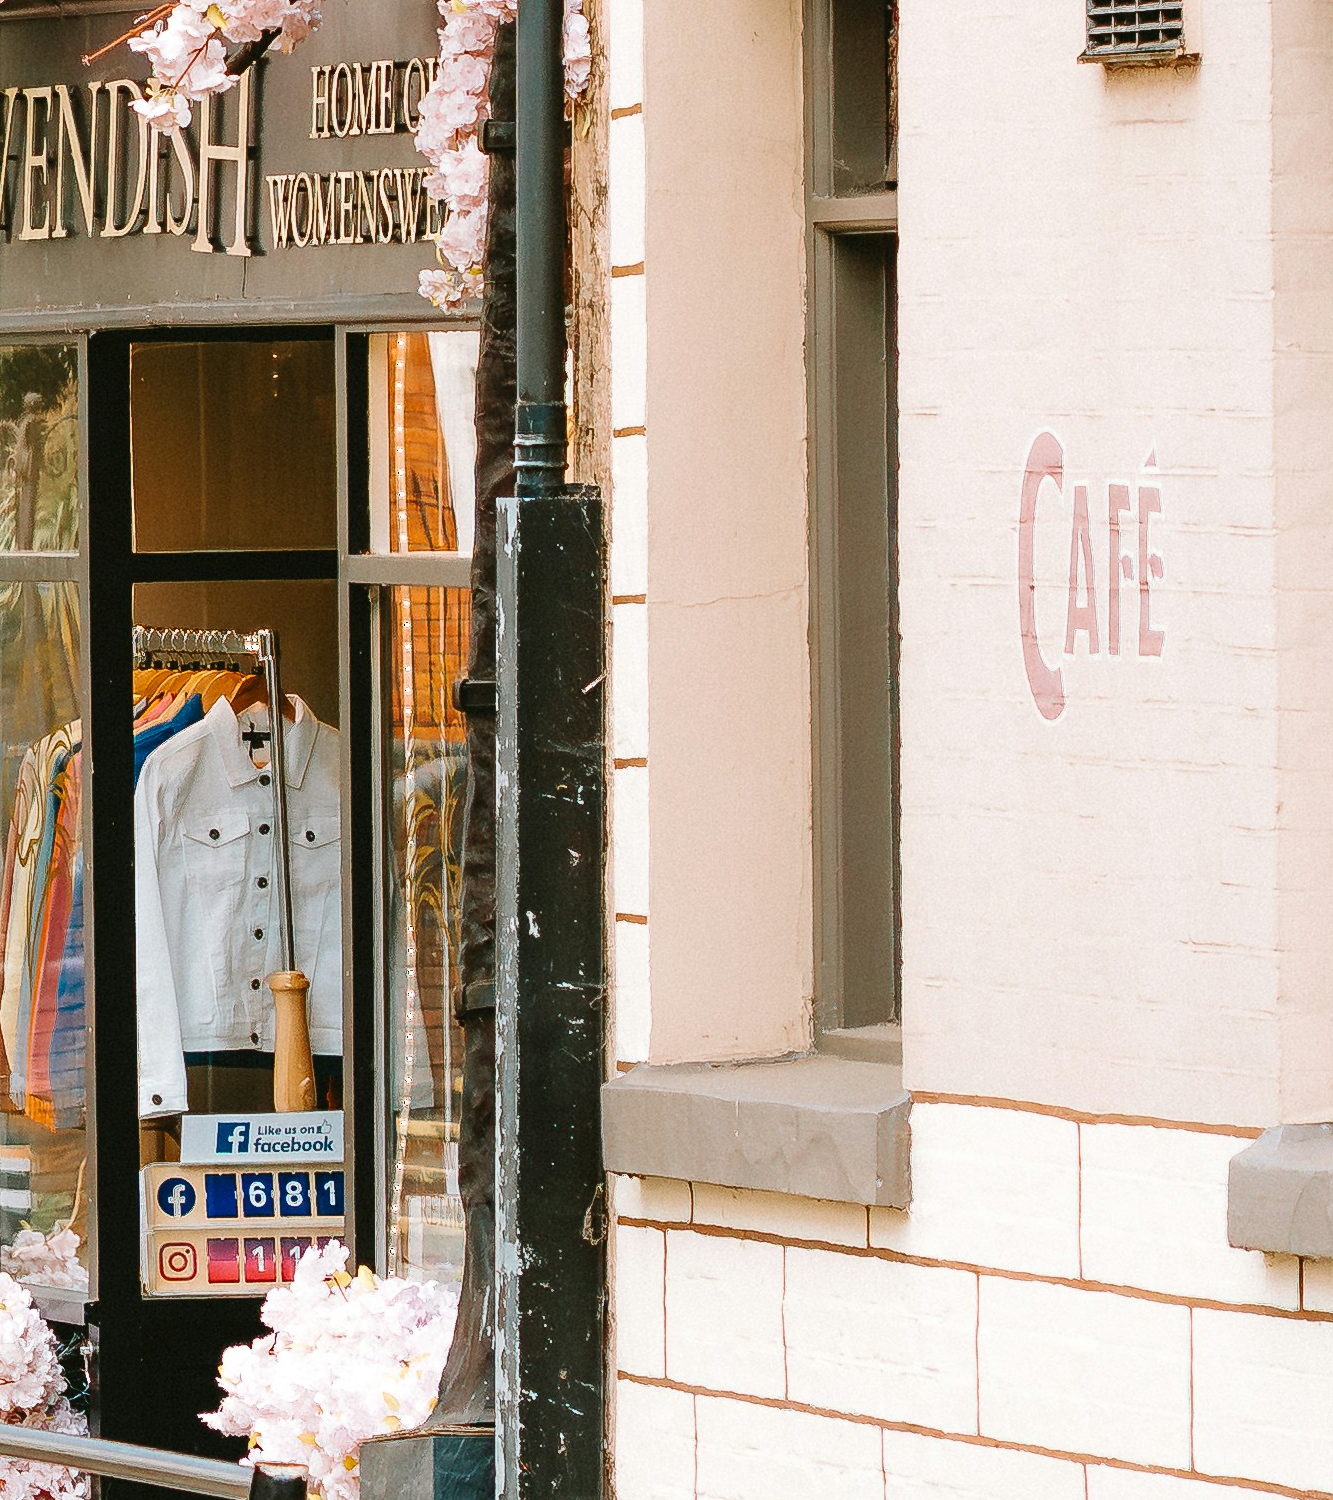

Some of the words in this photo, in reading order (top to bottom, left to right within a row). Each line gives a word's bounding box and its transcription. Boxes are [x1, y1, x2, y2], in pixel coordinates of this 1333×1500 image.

[309, 58, 395, 139] HOME
[265, 166, 450, 250] WOMENSWE
[1018, 431, 1165, 721] CAFÉ
[253, 1136, 334, 1153] facebook
[258, 1126, 282, 1136] Like
[284, 1127, 297, 1136] us
[300, 1126, 315, 1134] on
[248, 1180, 336, 1208] 681
